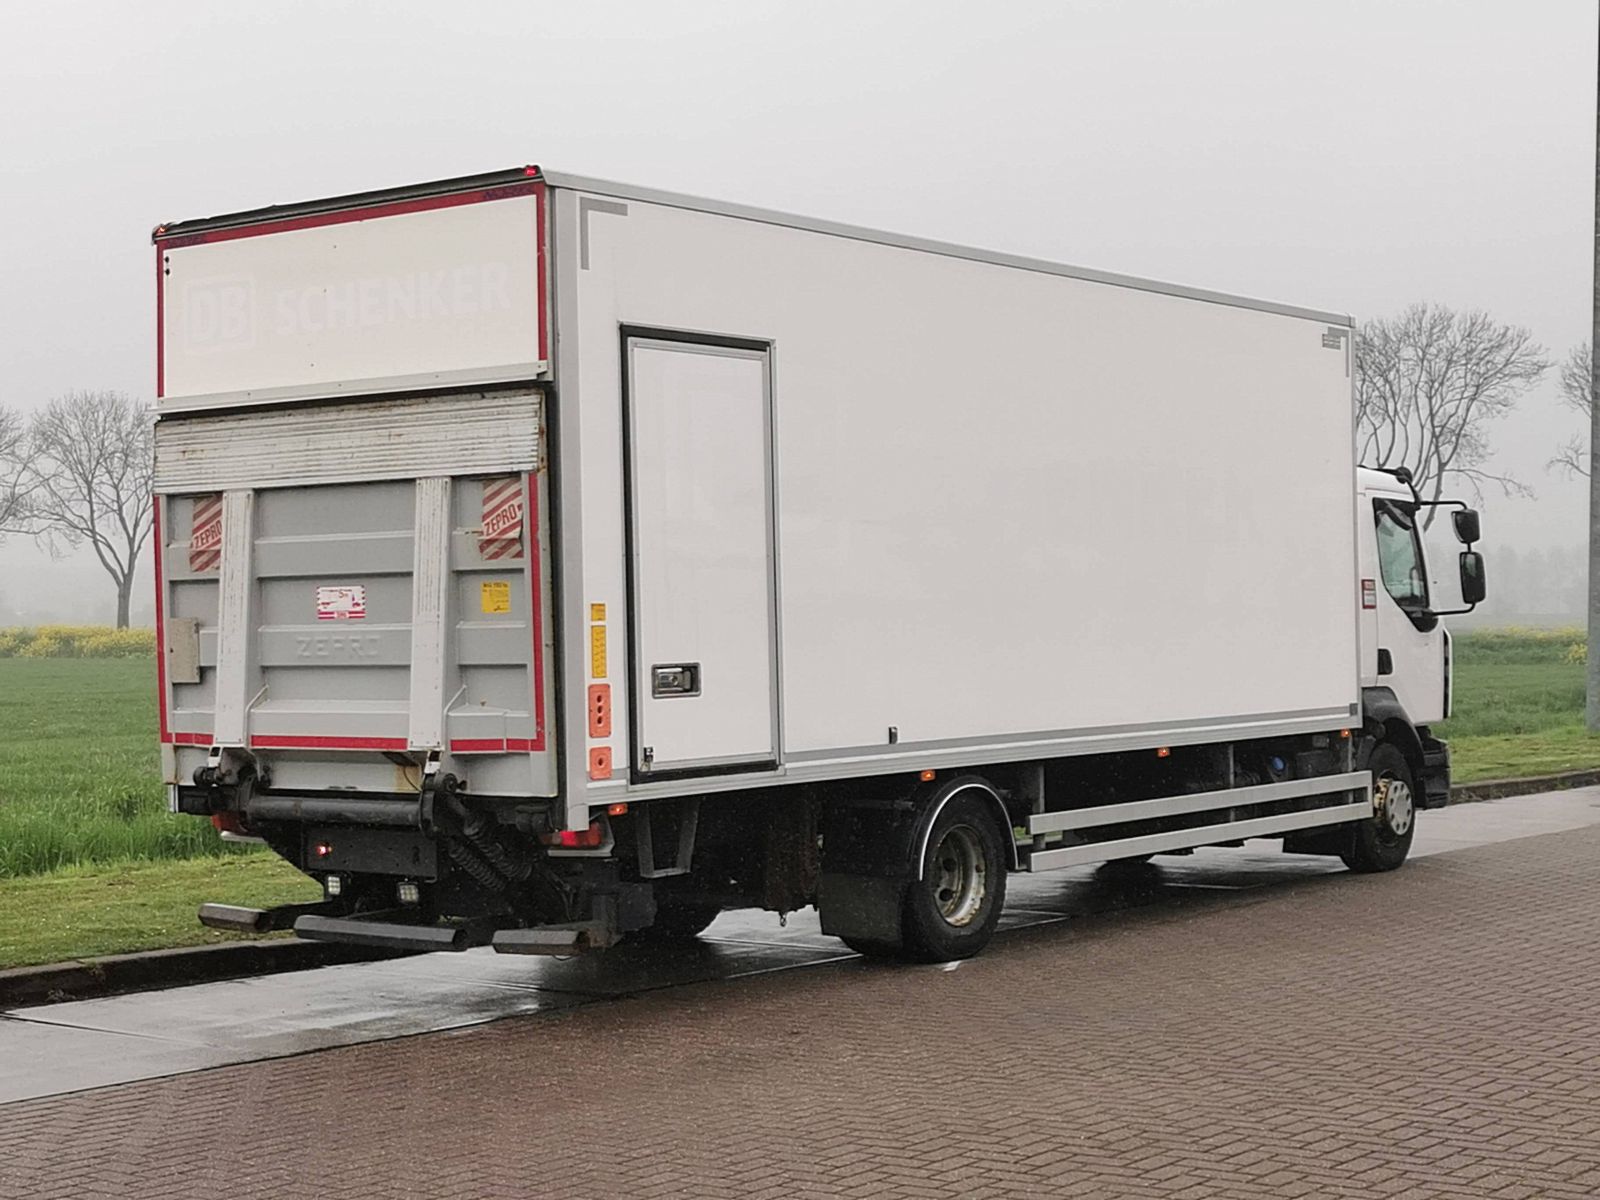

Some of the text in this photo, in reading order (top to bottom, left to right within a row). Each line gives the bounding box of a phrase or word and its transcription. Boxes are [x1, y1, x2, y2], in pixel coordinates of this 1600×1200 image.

[187, 262, 511, 343] DB SCHENKER
[193, 519, 223, 550] ZEPRO
[484, 503, 518, 537] ZEPRO
